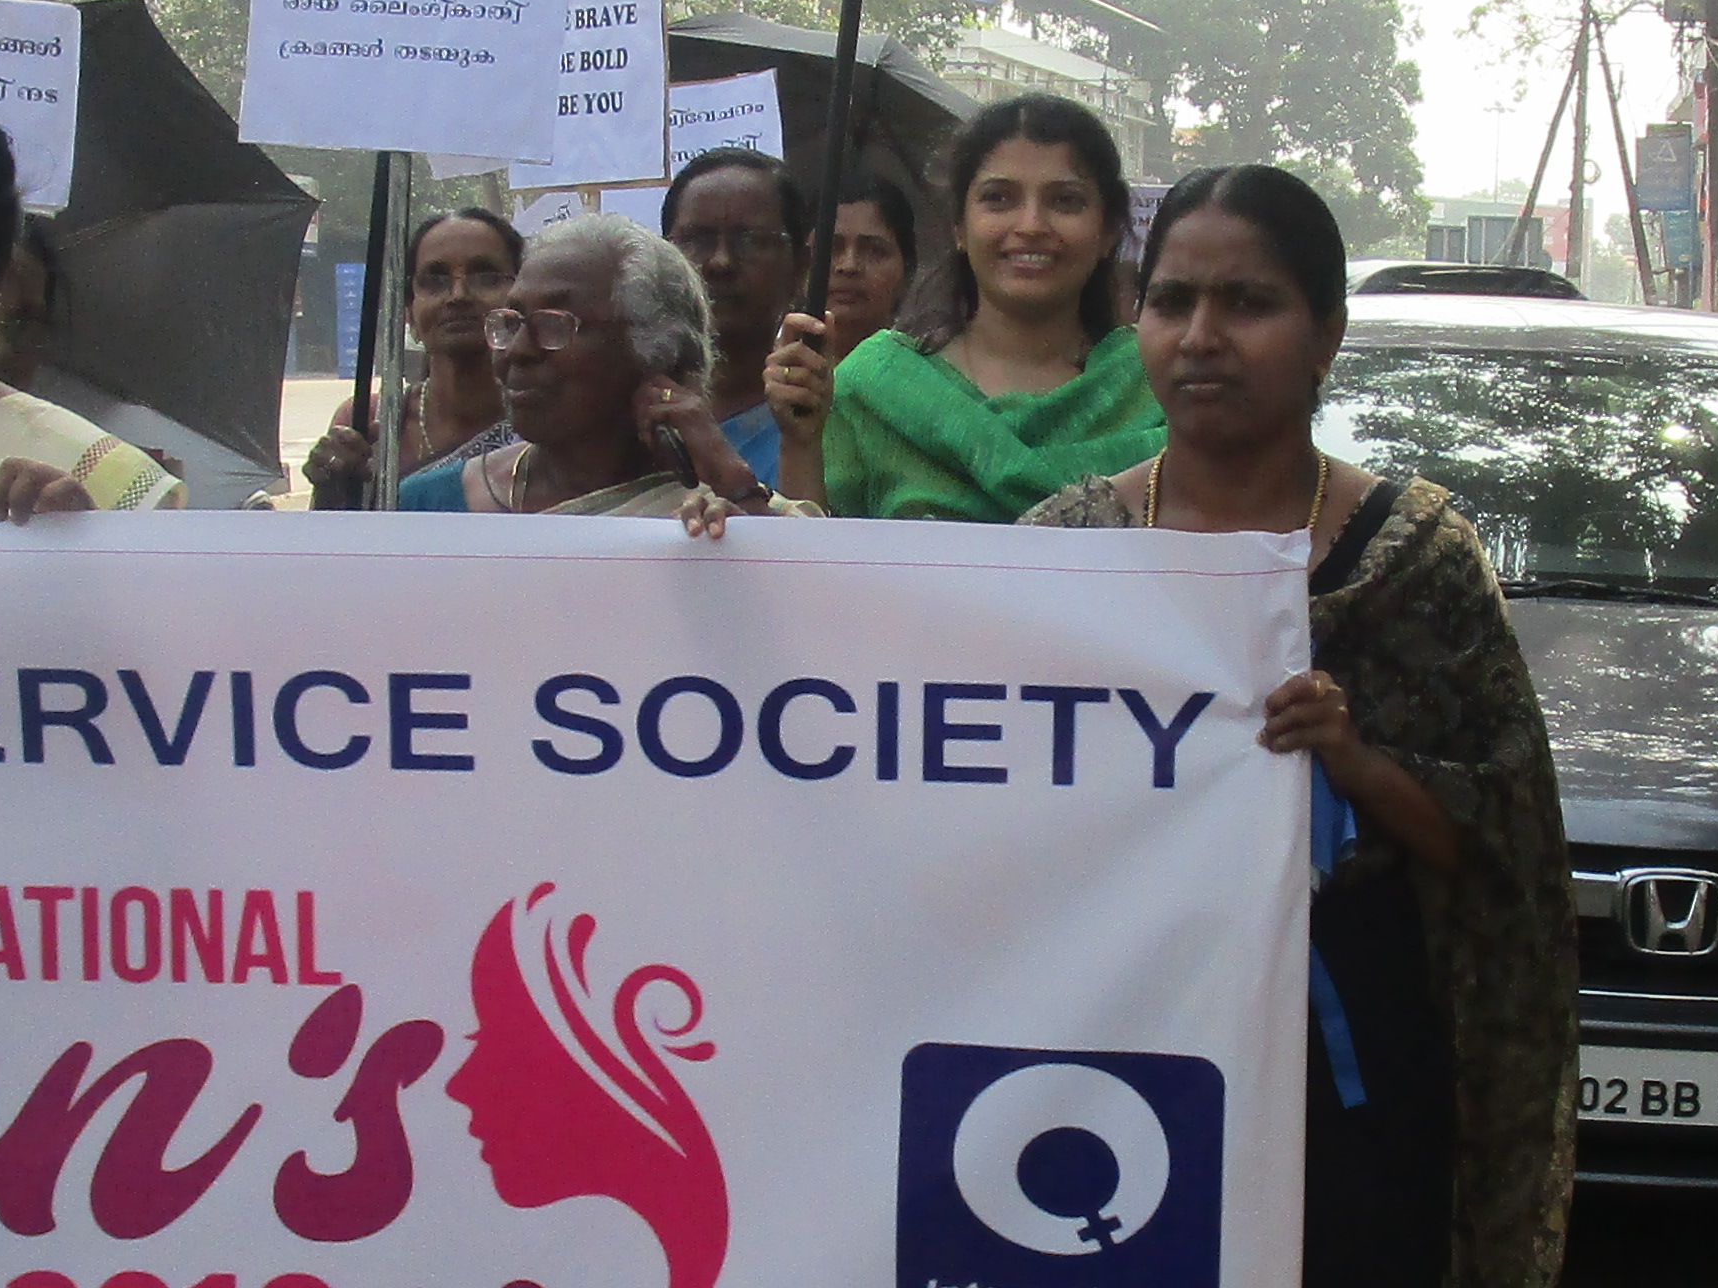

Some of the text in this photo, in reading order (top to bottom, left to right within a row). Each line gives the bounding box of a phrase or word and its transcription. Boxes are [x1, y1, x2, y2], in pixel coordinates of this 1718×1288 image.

[575, 3, 638, 30] BRAVE
[580, 48, 629, 72] BOLD
[558, 91, 624, 117] BE YOU
[532, 673, 1216, 789] SOCIETY
[1579, 1076, 1627, 1114] 02
[1640, 1079, 1701, 1119] BB
